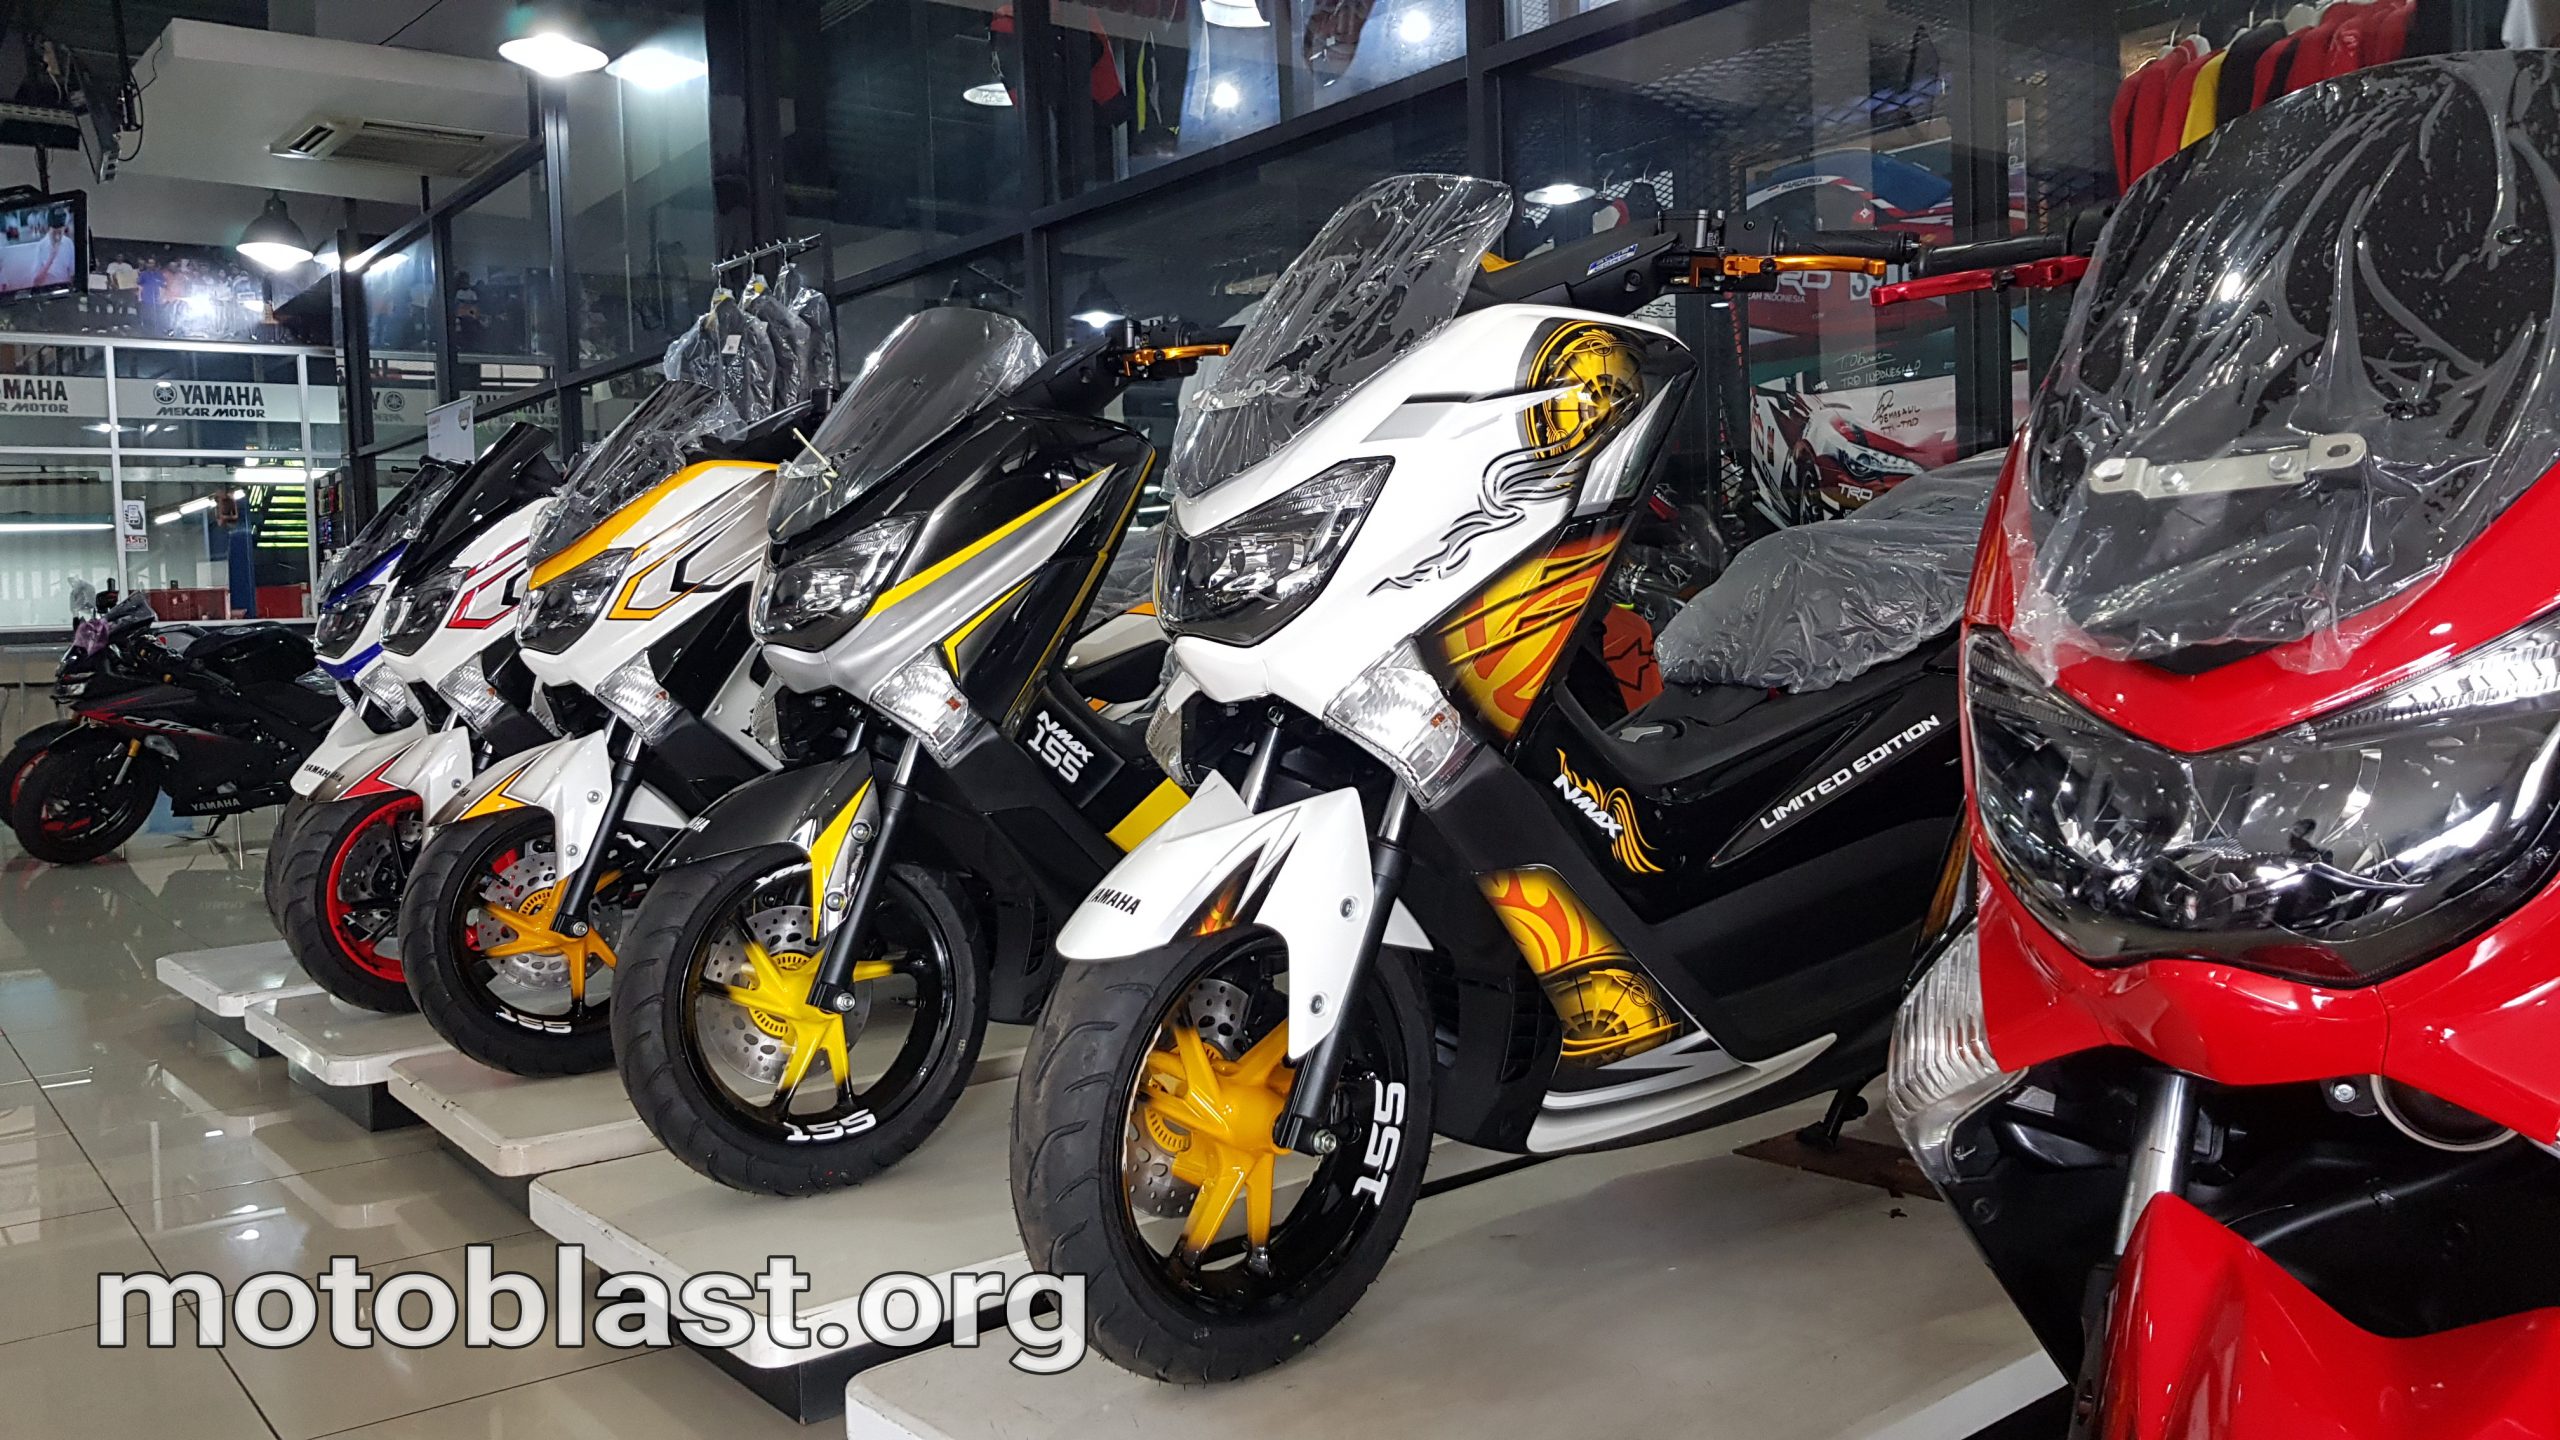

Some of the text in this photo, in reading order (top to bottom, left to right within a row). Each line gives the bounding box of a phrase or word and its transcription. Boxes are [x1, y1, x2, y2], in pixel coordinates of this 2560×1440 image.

[1774, 271, 1832, 296] RD
[0, 379, 68, 401] MAHA
[180, 385, 264, 406] YAMAHA
[11, 403, 69, 414] MOTOR
[156, 407, 266, 418] MEKAR MOTOR
[1838, 483, 1873, 500] TRD
[1037, 710, 1094, 764] NMAX
[1027, 722, 1084, 783] 155
[1760, 714, 1940, 829] LIMITED EDITION
[191, 798, 240, 812] YAMAHA
[1552, 773, 1623, 839] NMAX
[495, 1005, 572, 1033] 155
[783, 1108, 877, 1140] 155
[1351, 1079, 1406, 1206] 155
